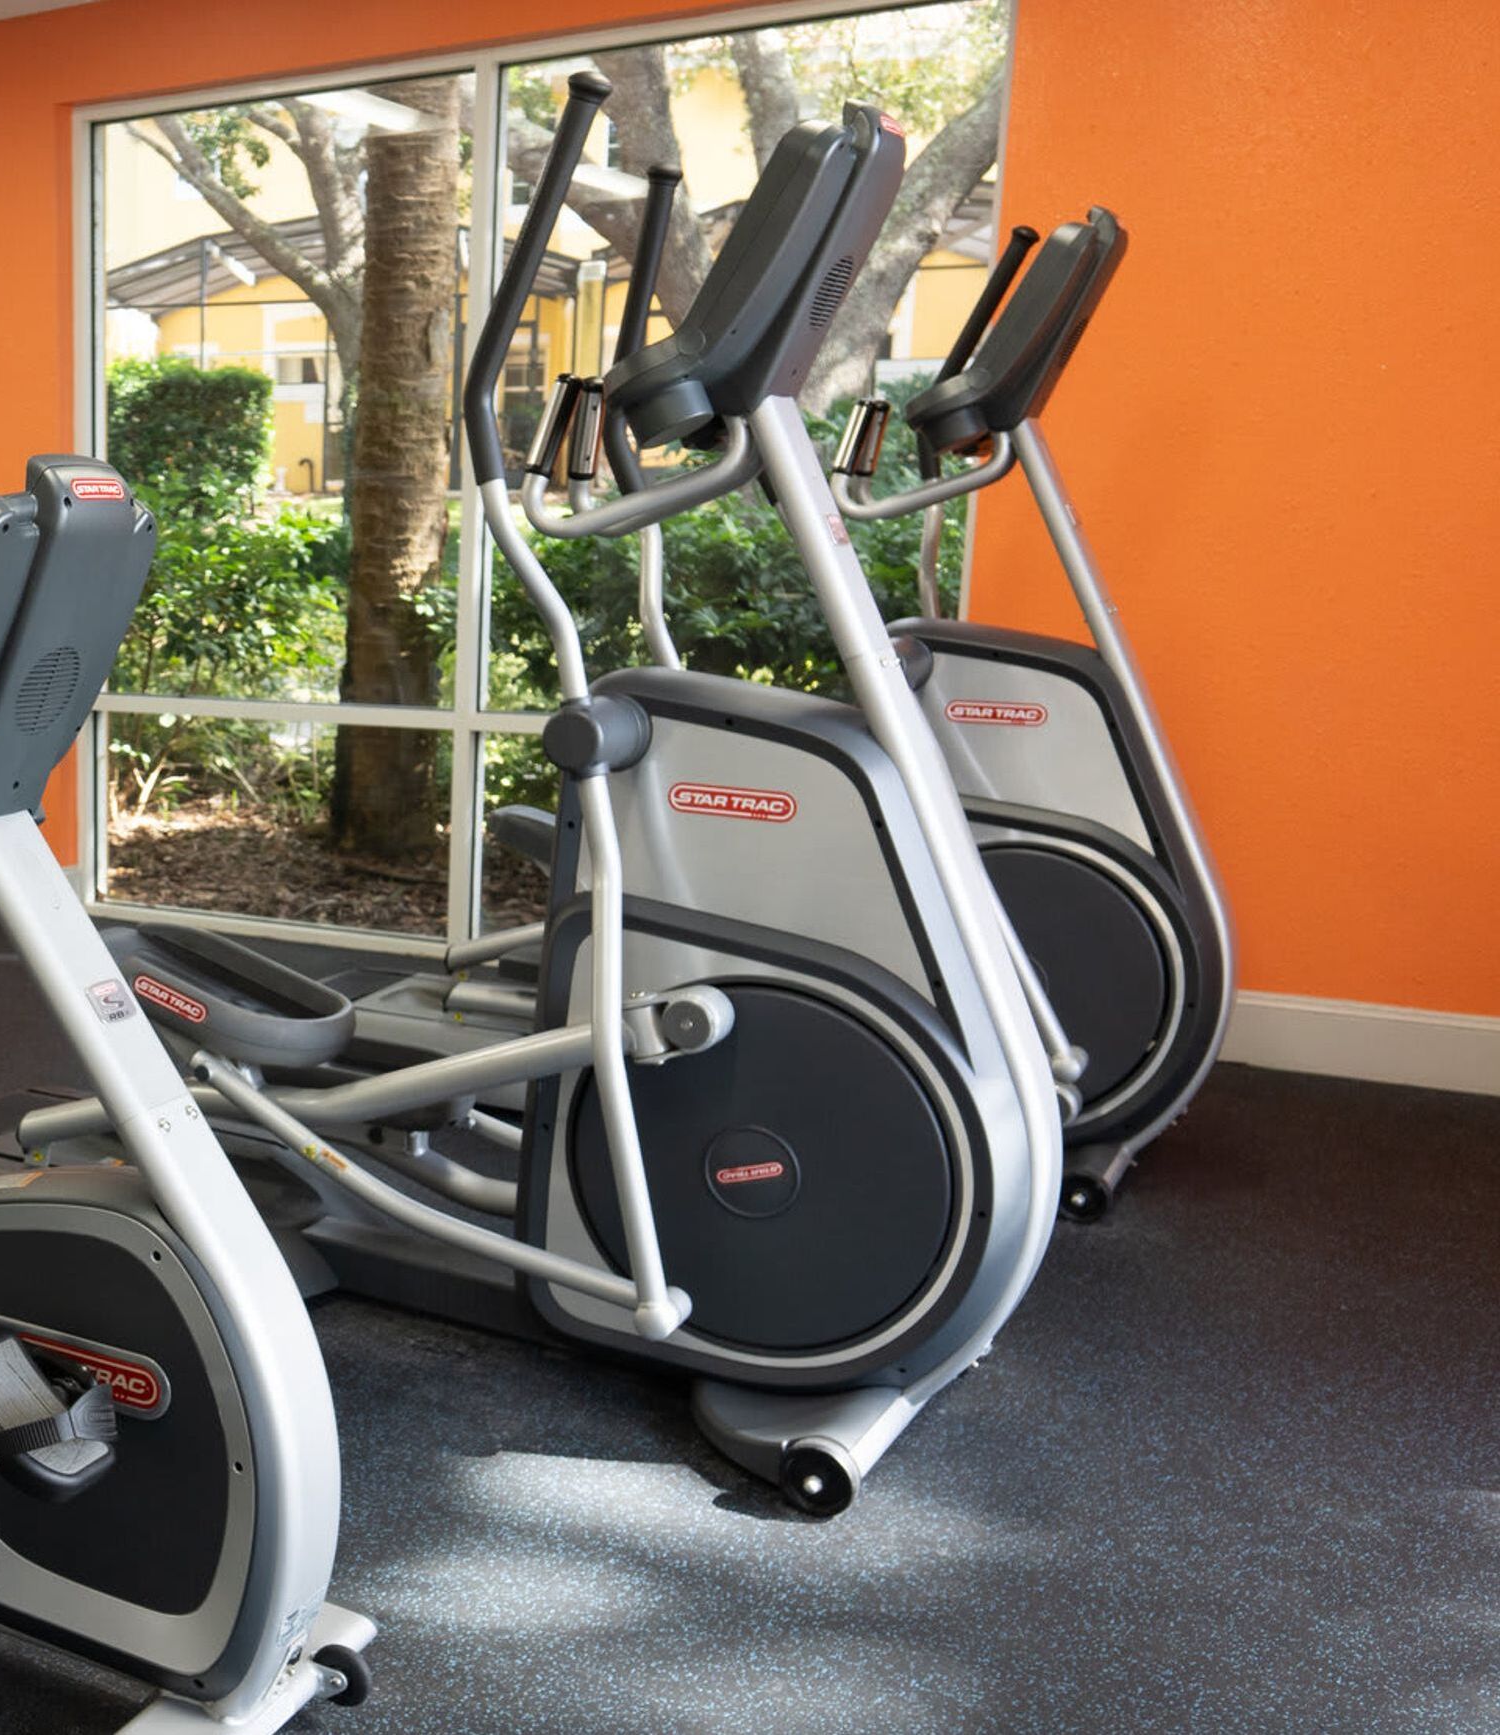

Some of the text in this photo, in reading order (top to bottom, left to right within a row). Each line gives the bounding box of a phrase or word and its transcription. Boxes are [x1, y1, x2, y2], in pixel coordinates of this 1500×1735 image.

[76, 484, 119, 494] STAR TRAC
[952, 706, 1038, 720] STAR TRAC
[677, 791, 785, 813] STAR TRAC
[139, 981, 169, 1001] STAR
[169, 995, 201, 1017] TRAC
